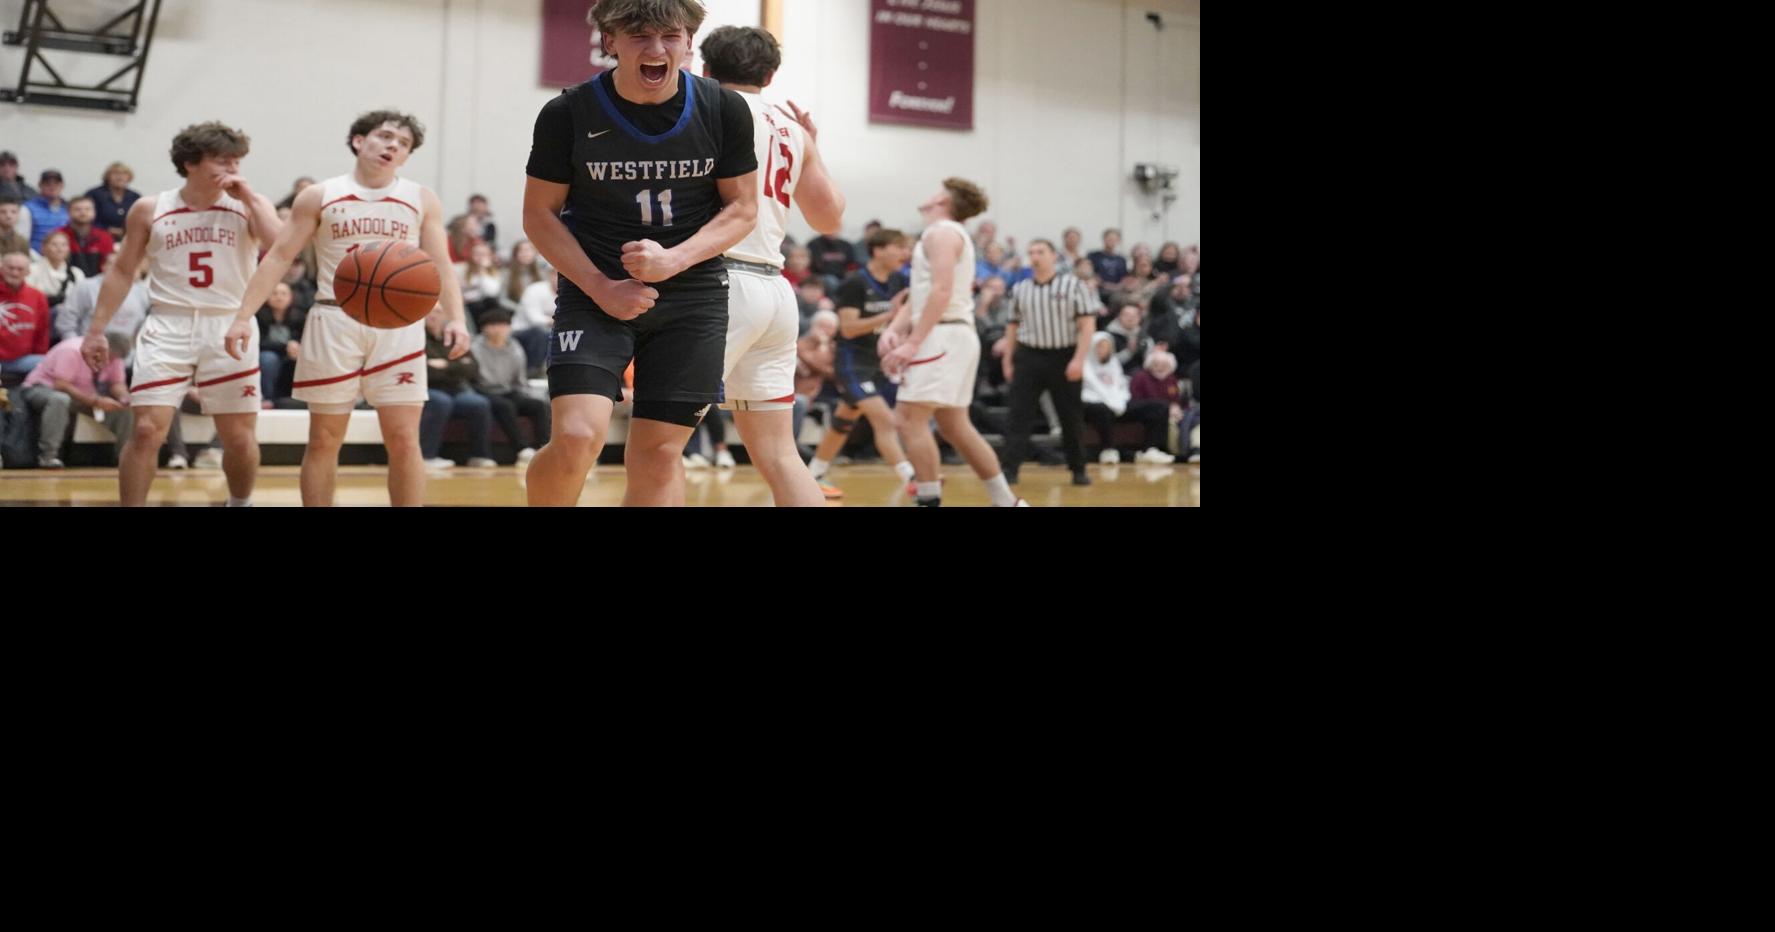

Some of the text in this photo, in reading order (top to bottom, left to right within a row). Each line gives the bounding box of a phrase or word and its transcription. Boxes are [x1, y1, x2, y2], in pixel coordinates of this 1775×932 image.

[586, 158, 715, 181] WESTFIELD
[764, 135, 794, 209] 12
[636, 189, 673, 227] 11
[166, 227, 236, 250] RANDOLPH
[331, 218, 409, 240] RANDOLPH
[189, 251, 213, 288] 5
[558, 330, 584, 352] W
